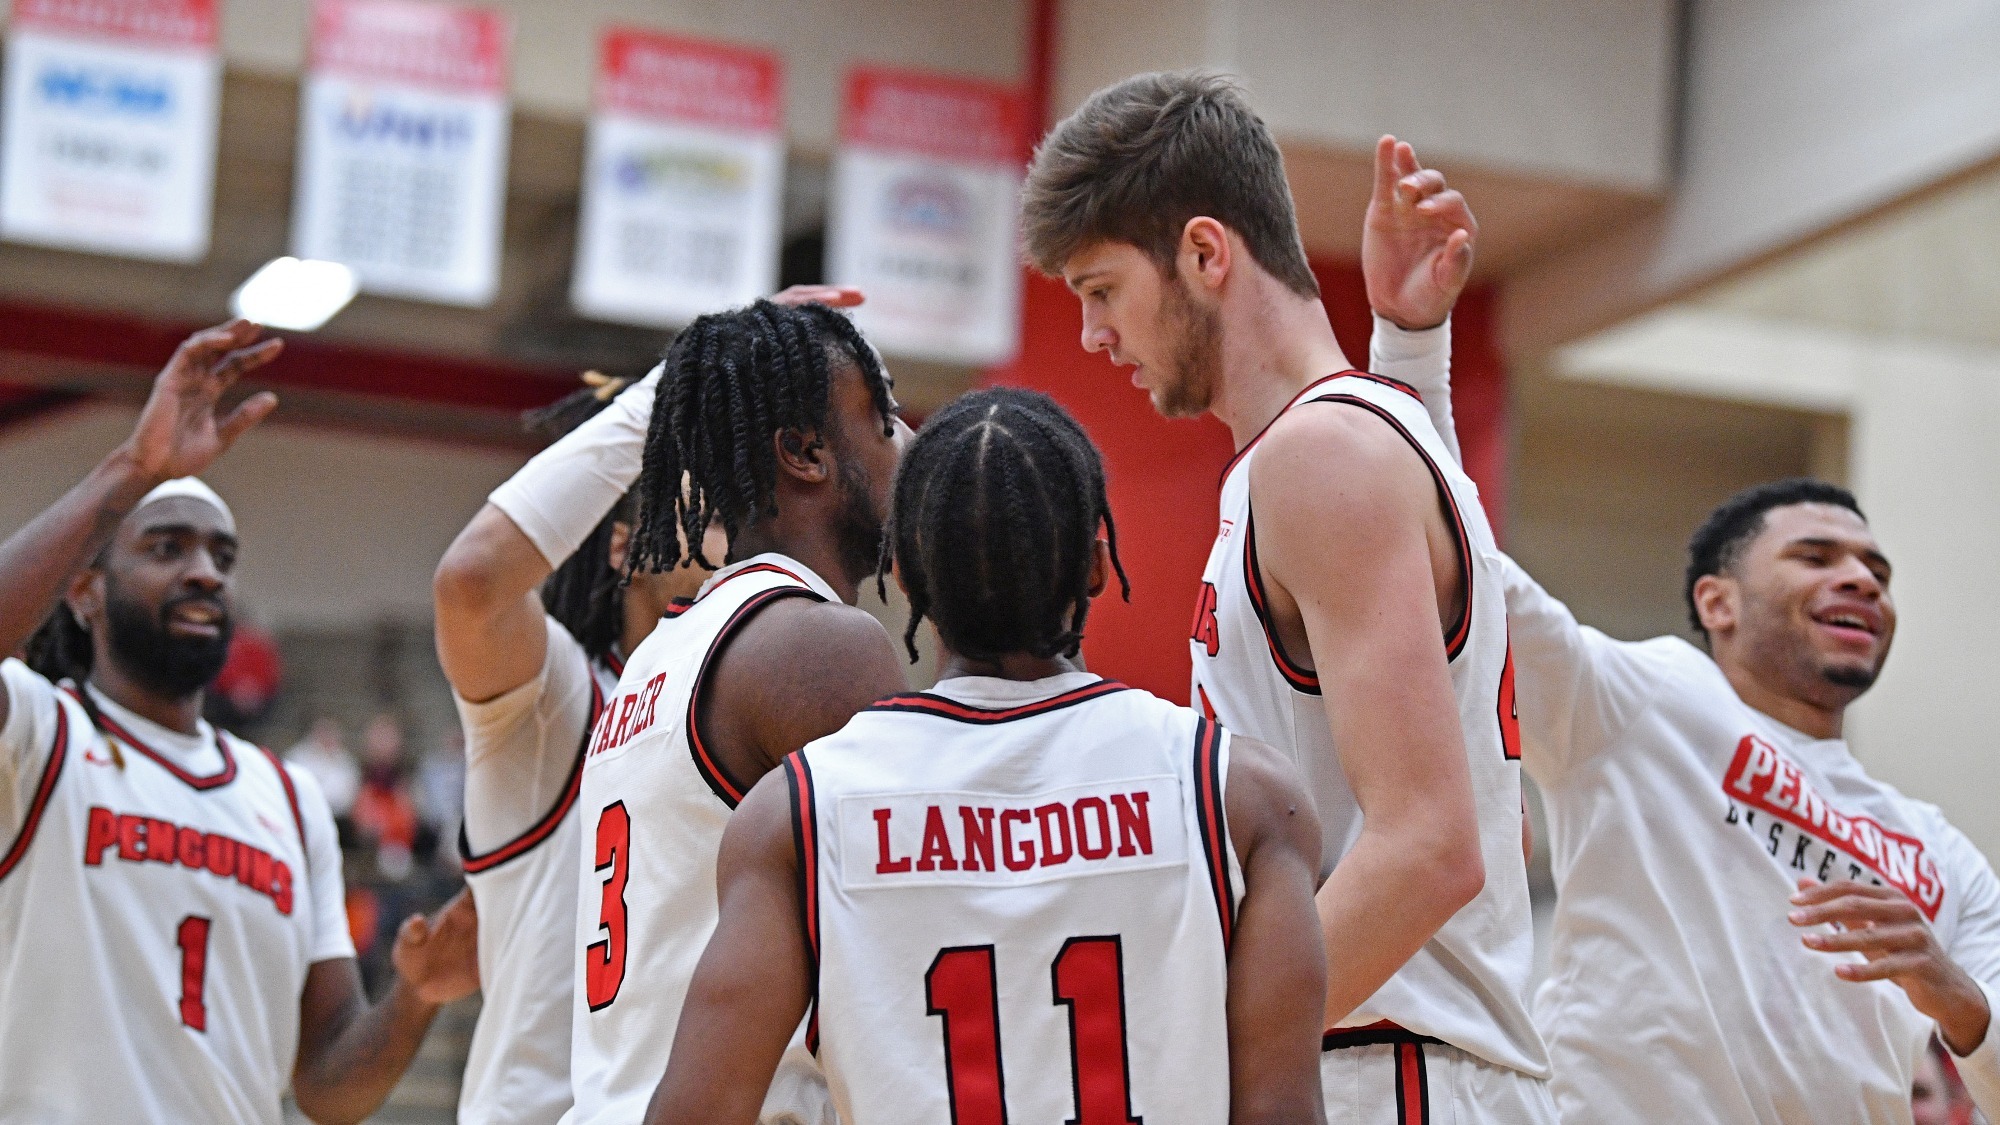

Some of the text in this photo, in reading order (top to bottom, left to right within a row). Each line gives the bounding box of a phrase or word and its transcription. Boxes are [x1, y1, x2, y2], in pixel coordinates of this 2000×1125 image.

[85, 806, 293, 916] PENGUINS
[873, 792, 1153, 874] LANGDON
[586, 799, 631, 1013] 3
[177, 915, 210, 1033] 1
[924, 934, 1143, 1125] 11
